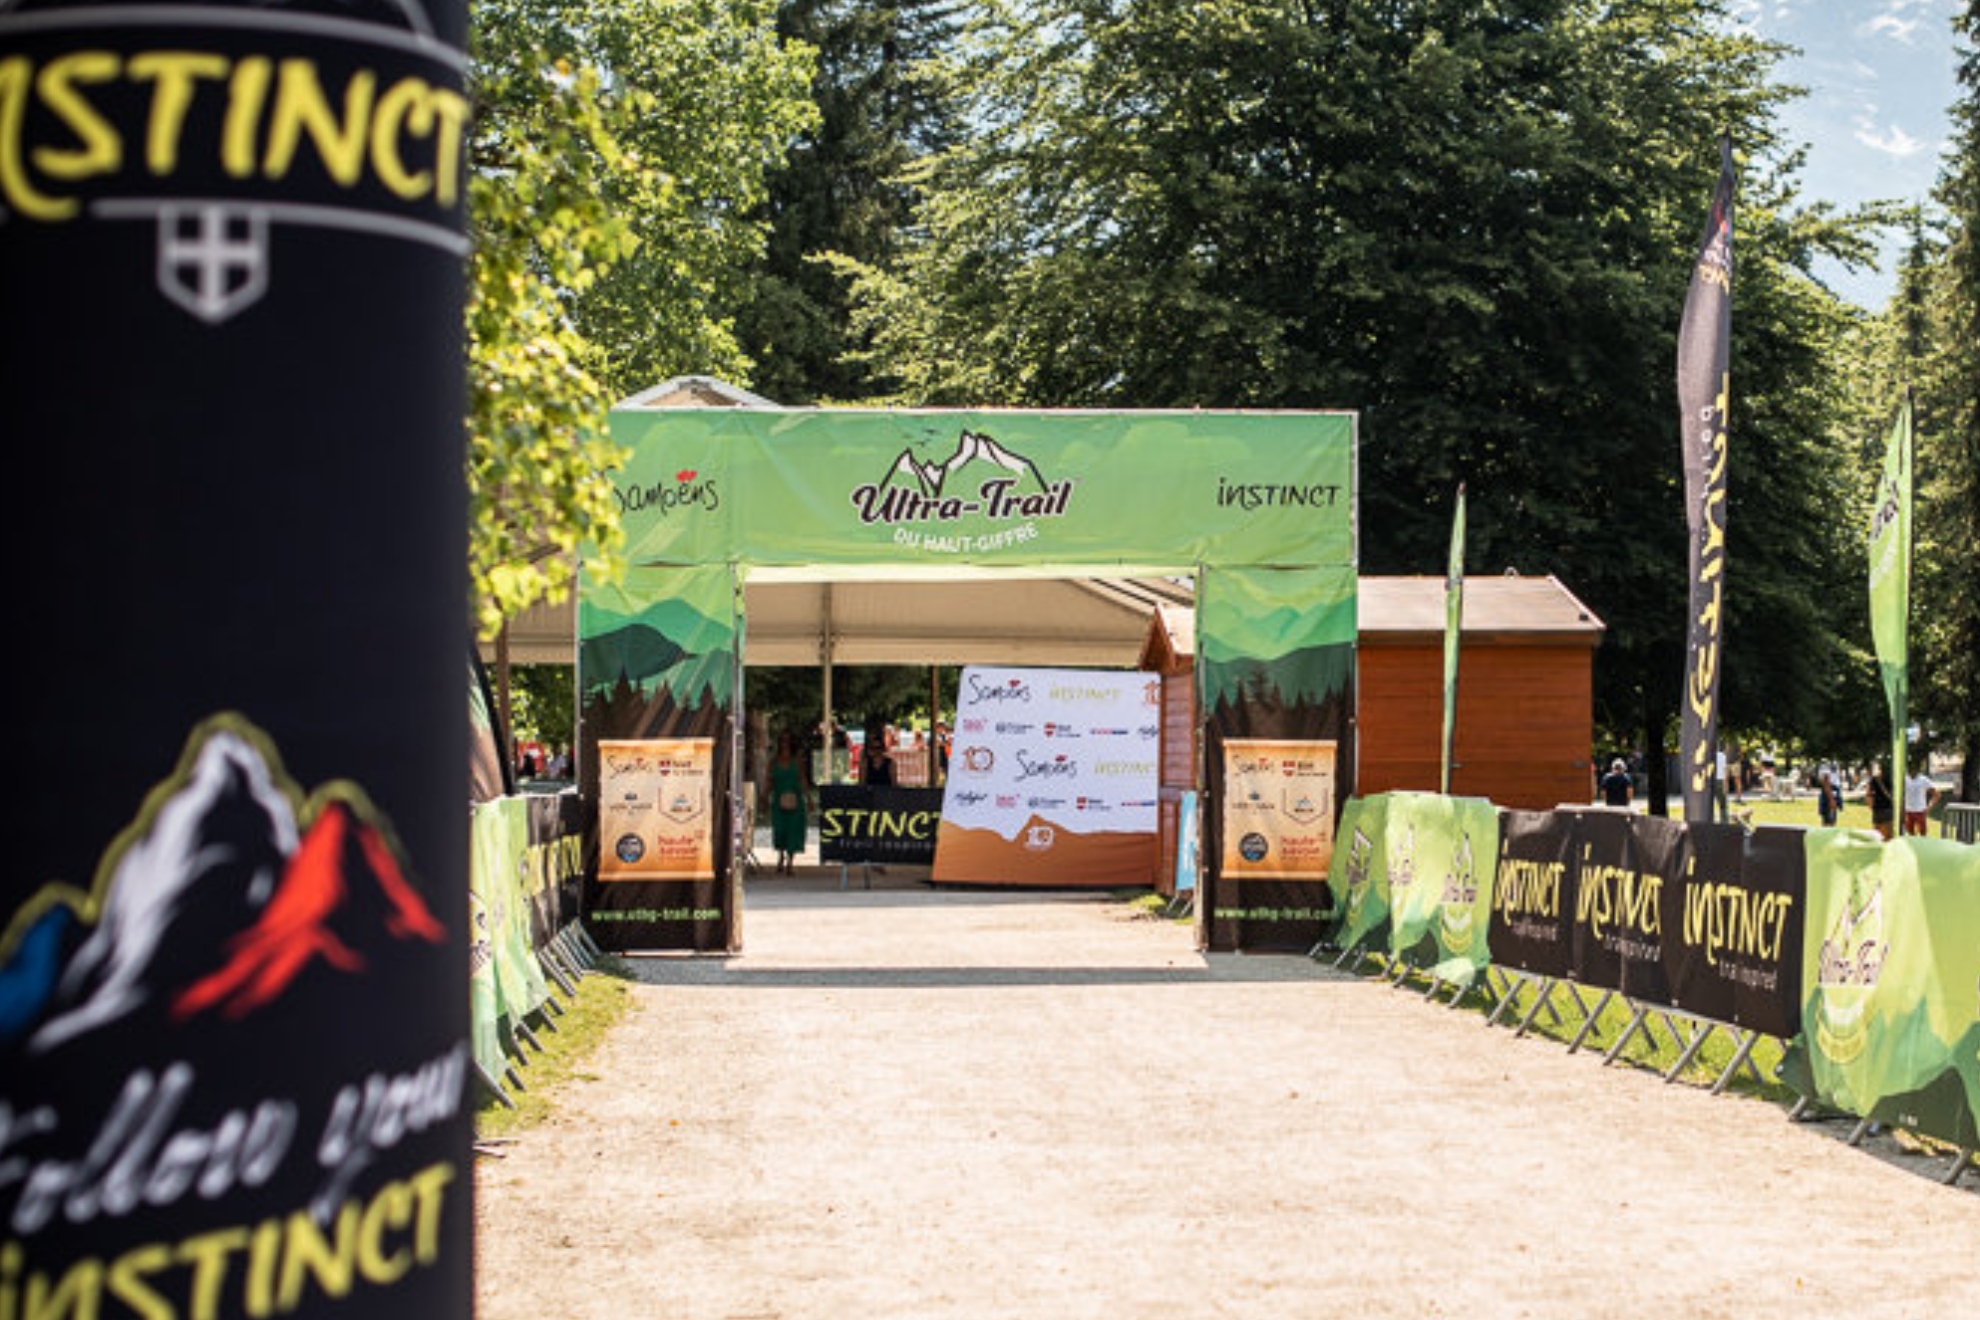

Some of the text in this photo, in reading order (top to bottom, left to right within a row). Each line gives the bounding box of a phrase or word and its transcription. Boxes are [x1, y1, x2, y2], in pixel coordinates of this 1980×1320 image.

[851, 479, 1073, 523] Ultra-Trail
[893, 521, 1039, 553] DU HAUT-GIFFRE
